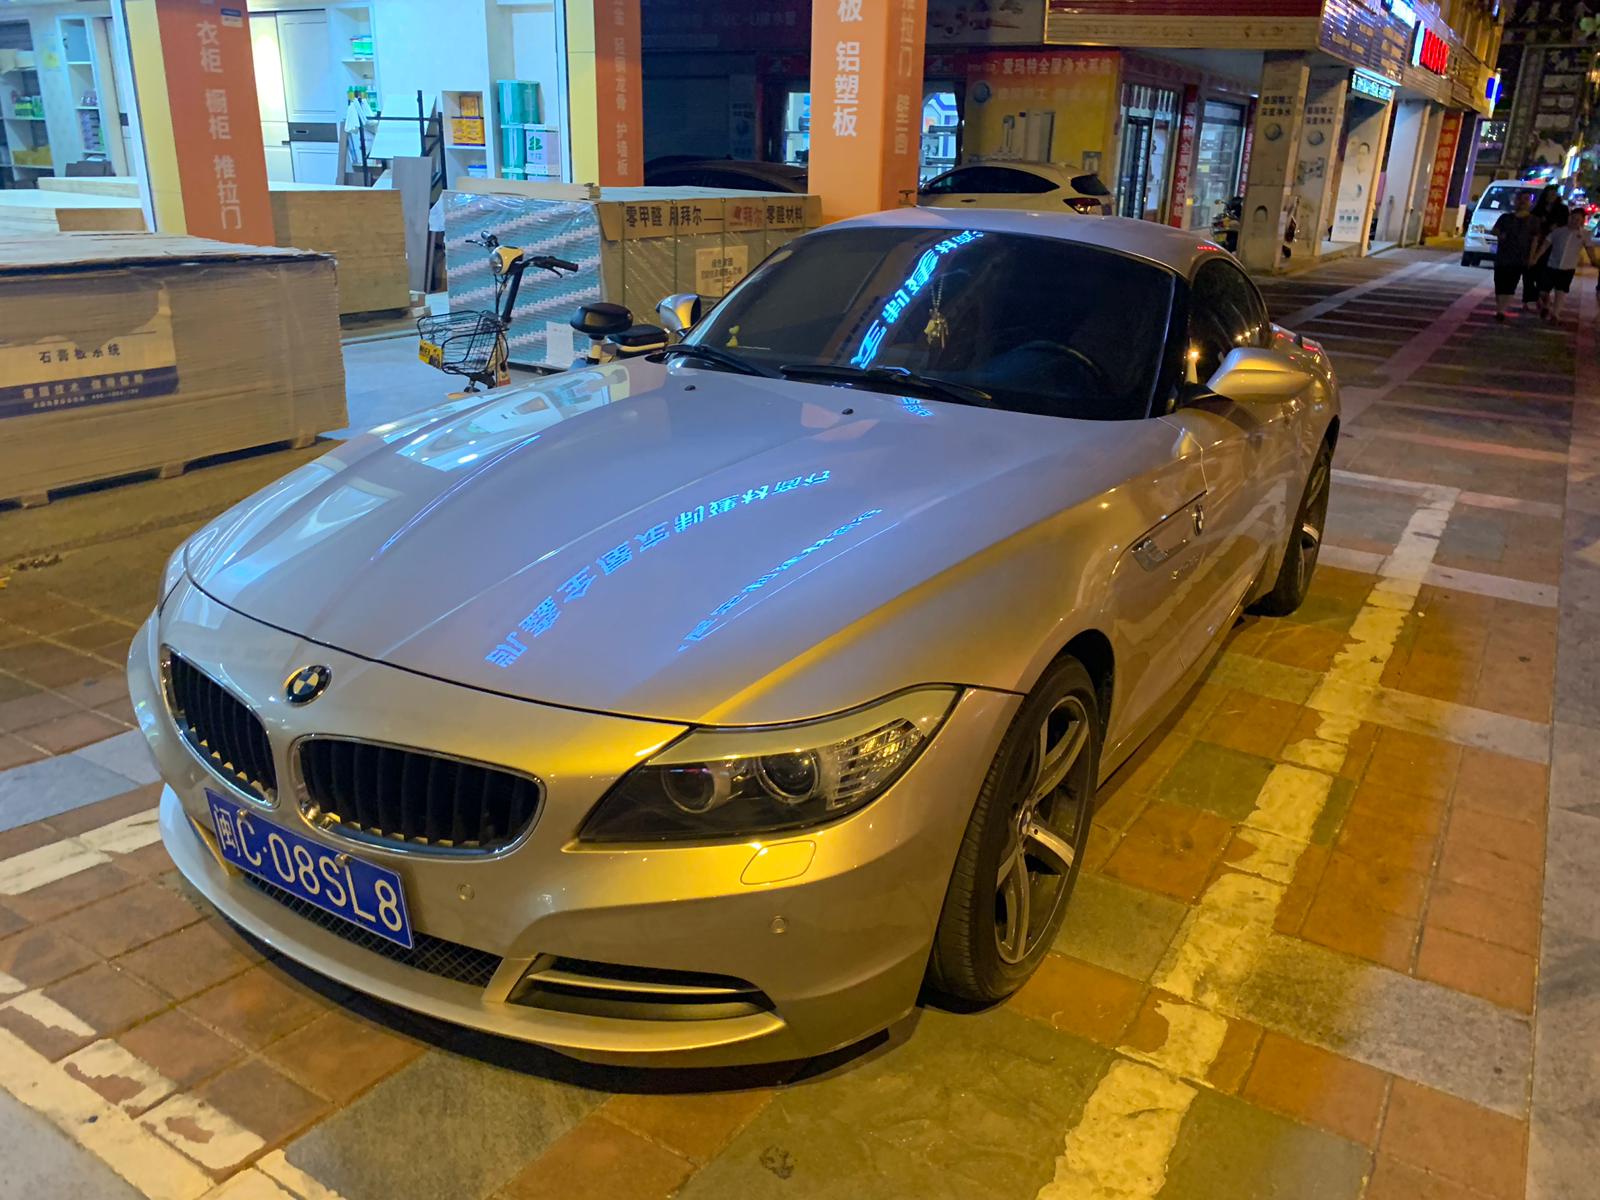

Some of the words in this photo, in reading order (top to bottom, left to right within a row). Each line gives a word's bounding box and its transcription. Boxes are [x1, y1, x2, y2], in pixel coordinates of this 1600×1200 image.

[197, 20, 224, 73] 衣柜
[213, 155, 242, 230] 推拉门
[832, 41, 861, 137] 铝塑板
[625, 205, 662, 228] 零甲醛
